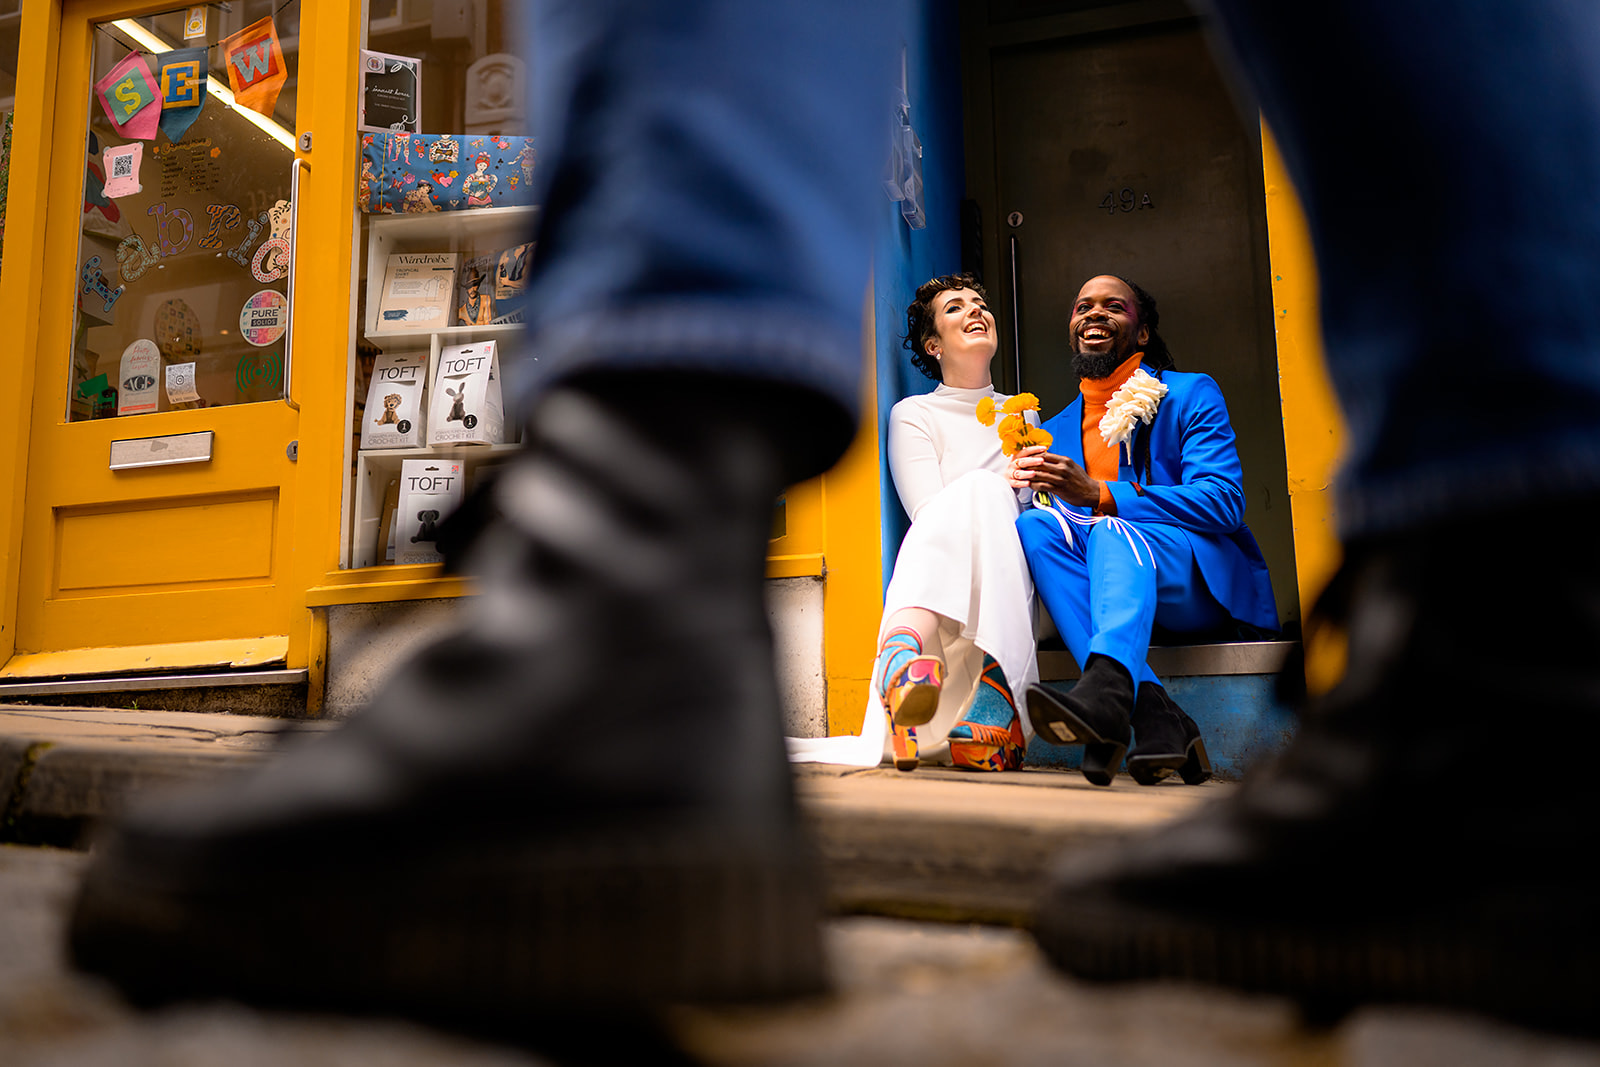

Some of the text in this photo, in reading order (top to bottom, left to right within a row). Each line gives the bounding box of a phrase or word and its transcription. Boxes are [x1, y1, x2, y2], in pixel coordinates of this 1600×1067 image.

[252, 309, 279, 318] PURE
[445, 357, 486, 374] TOFT
[378, 365, 421, 381] TOFT
[368, 437, 399, 445] CROCHET
[435, 433, 466, 441] CROCHET
[408, 476, 455, 491] TOFT
